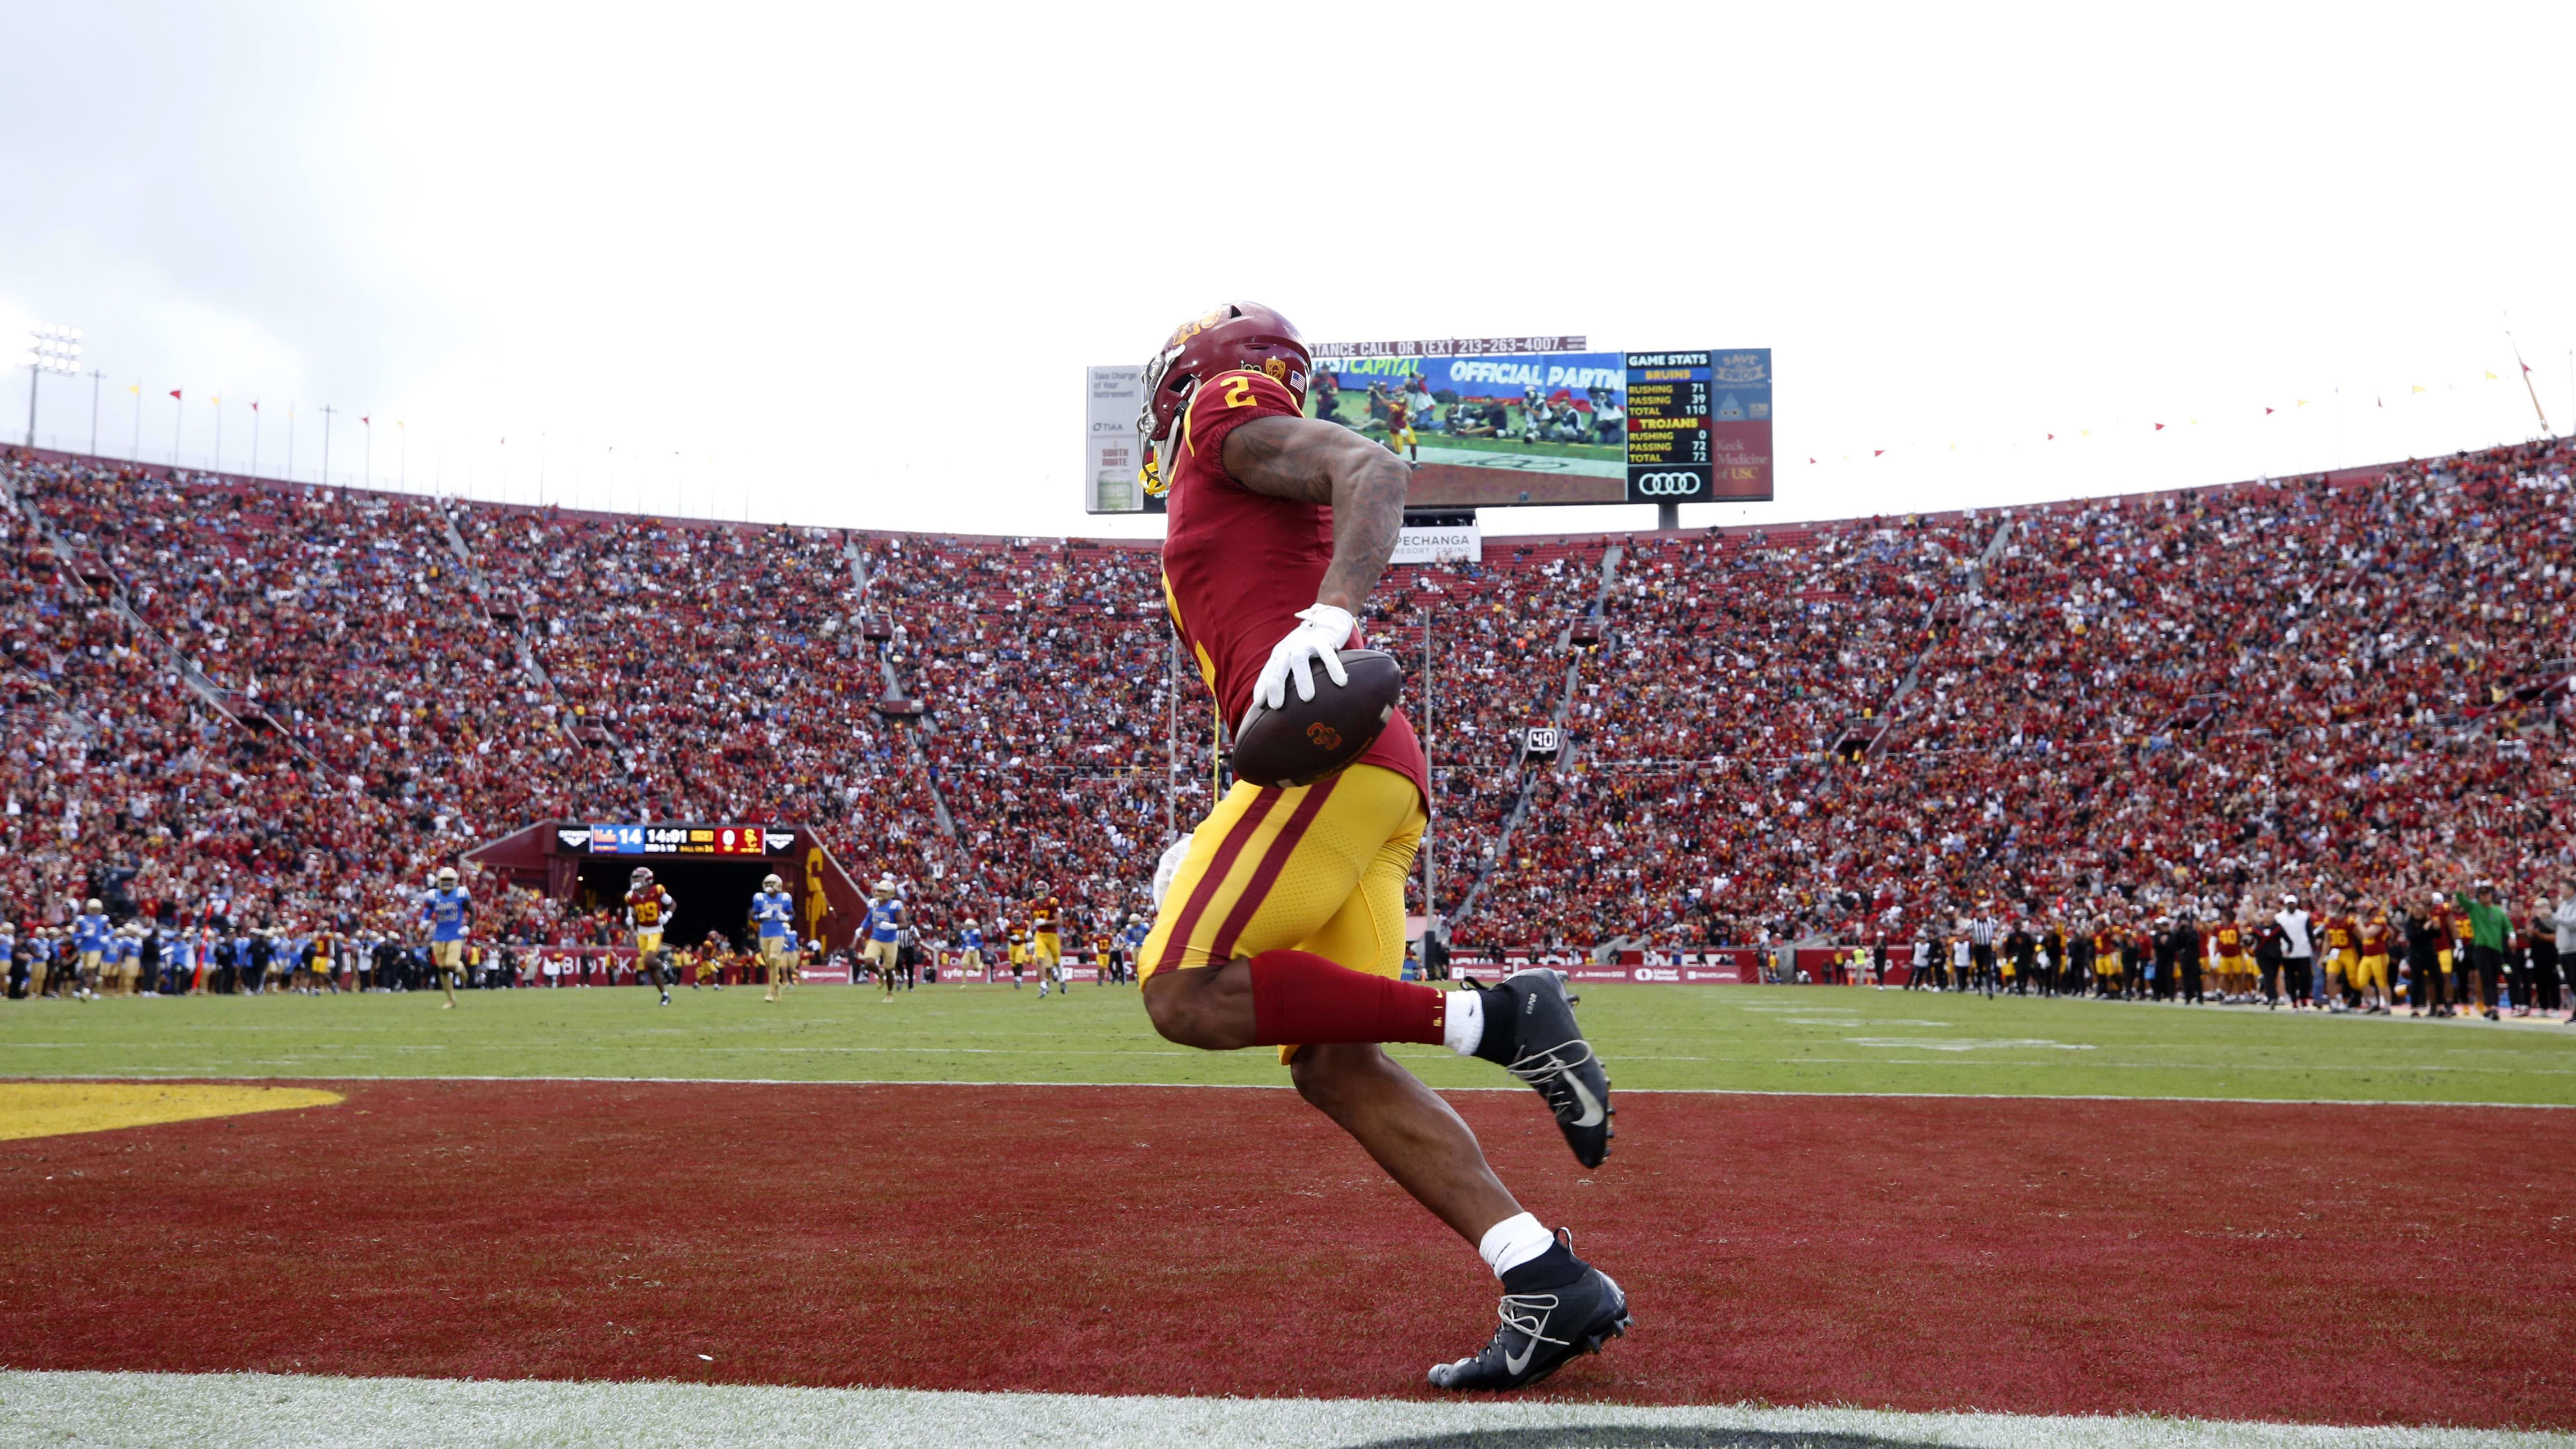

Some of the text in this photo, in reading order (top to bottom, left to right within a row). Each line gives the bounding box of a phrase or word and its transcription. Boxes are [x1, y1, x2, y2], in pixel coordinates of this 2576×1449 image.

[1360, 342, 1393, 355] CALL
[1397, 341, 1415, 354] OR
[1421, 339, 1454, 354] TEXT
[1459, 337, 1563, 353] 213-263-4007.
[1629, 354, 1707, 366] GAME STATS
[1112, 372, 1137, 381] Charge
[1450, 361, 1626, 391] OFFICIAL PARTN
[1645, 370, 1691, 380] BRUINS
[1220, 376, 1257, 408] 2
[1628, 385, 1673, 394] RUSHING
[1692, 383, 1704, 393] 71
[1629, 394, 1706, 405] PASSING 39
[1629, 405, 1707, 415] TOTAL 110
[1639, 418, 1698, 429] TROJANS
[1629, 430, 1707, 441] RUSHING 0
[1629, 441, 1707, 452] PASSING 72
[1630, 451, 1707, 462] TOTAL 72
[1717, 454, 1769, 465] Medicine
[1732, 467, 1759, 479] USC
[1397, 536, 1469, 546] PECHANGA
[1533, 731, 1553, 747] 40
[619, 828, 642, 844] 14
[647, 829, 687, 843] 14:01
[722, 830, 735, 846] 0
